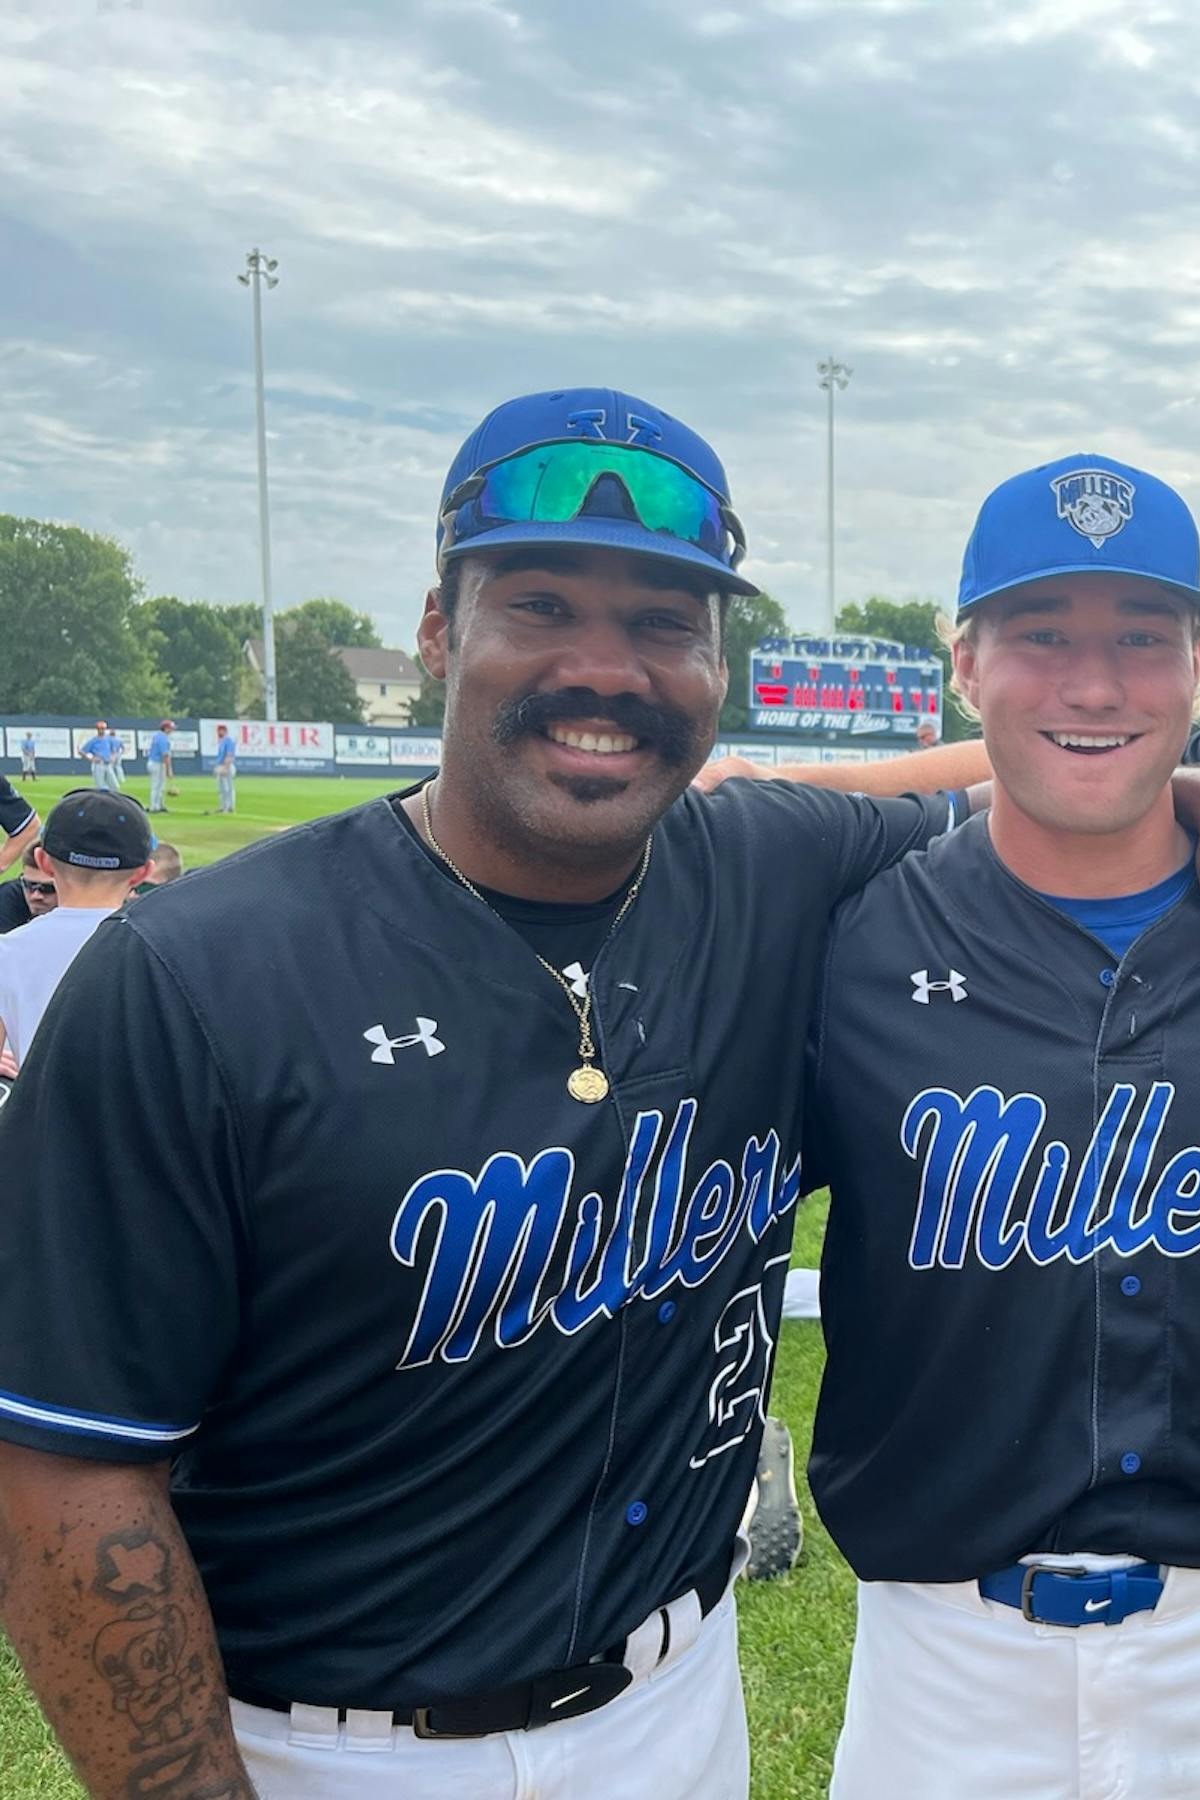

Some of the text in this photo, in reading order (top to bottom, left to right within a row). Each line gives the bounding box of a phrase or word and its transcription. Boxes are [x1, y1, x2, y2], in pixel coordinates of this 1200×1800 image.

[756, 711, 798, 728] HOME
[800, 713, 820, 727] OF
[822, 713, 851, 729] THE
[689, 1253, 791, 1469] 2
